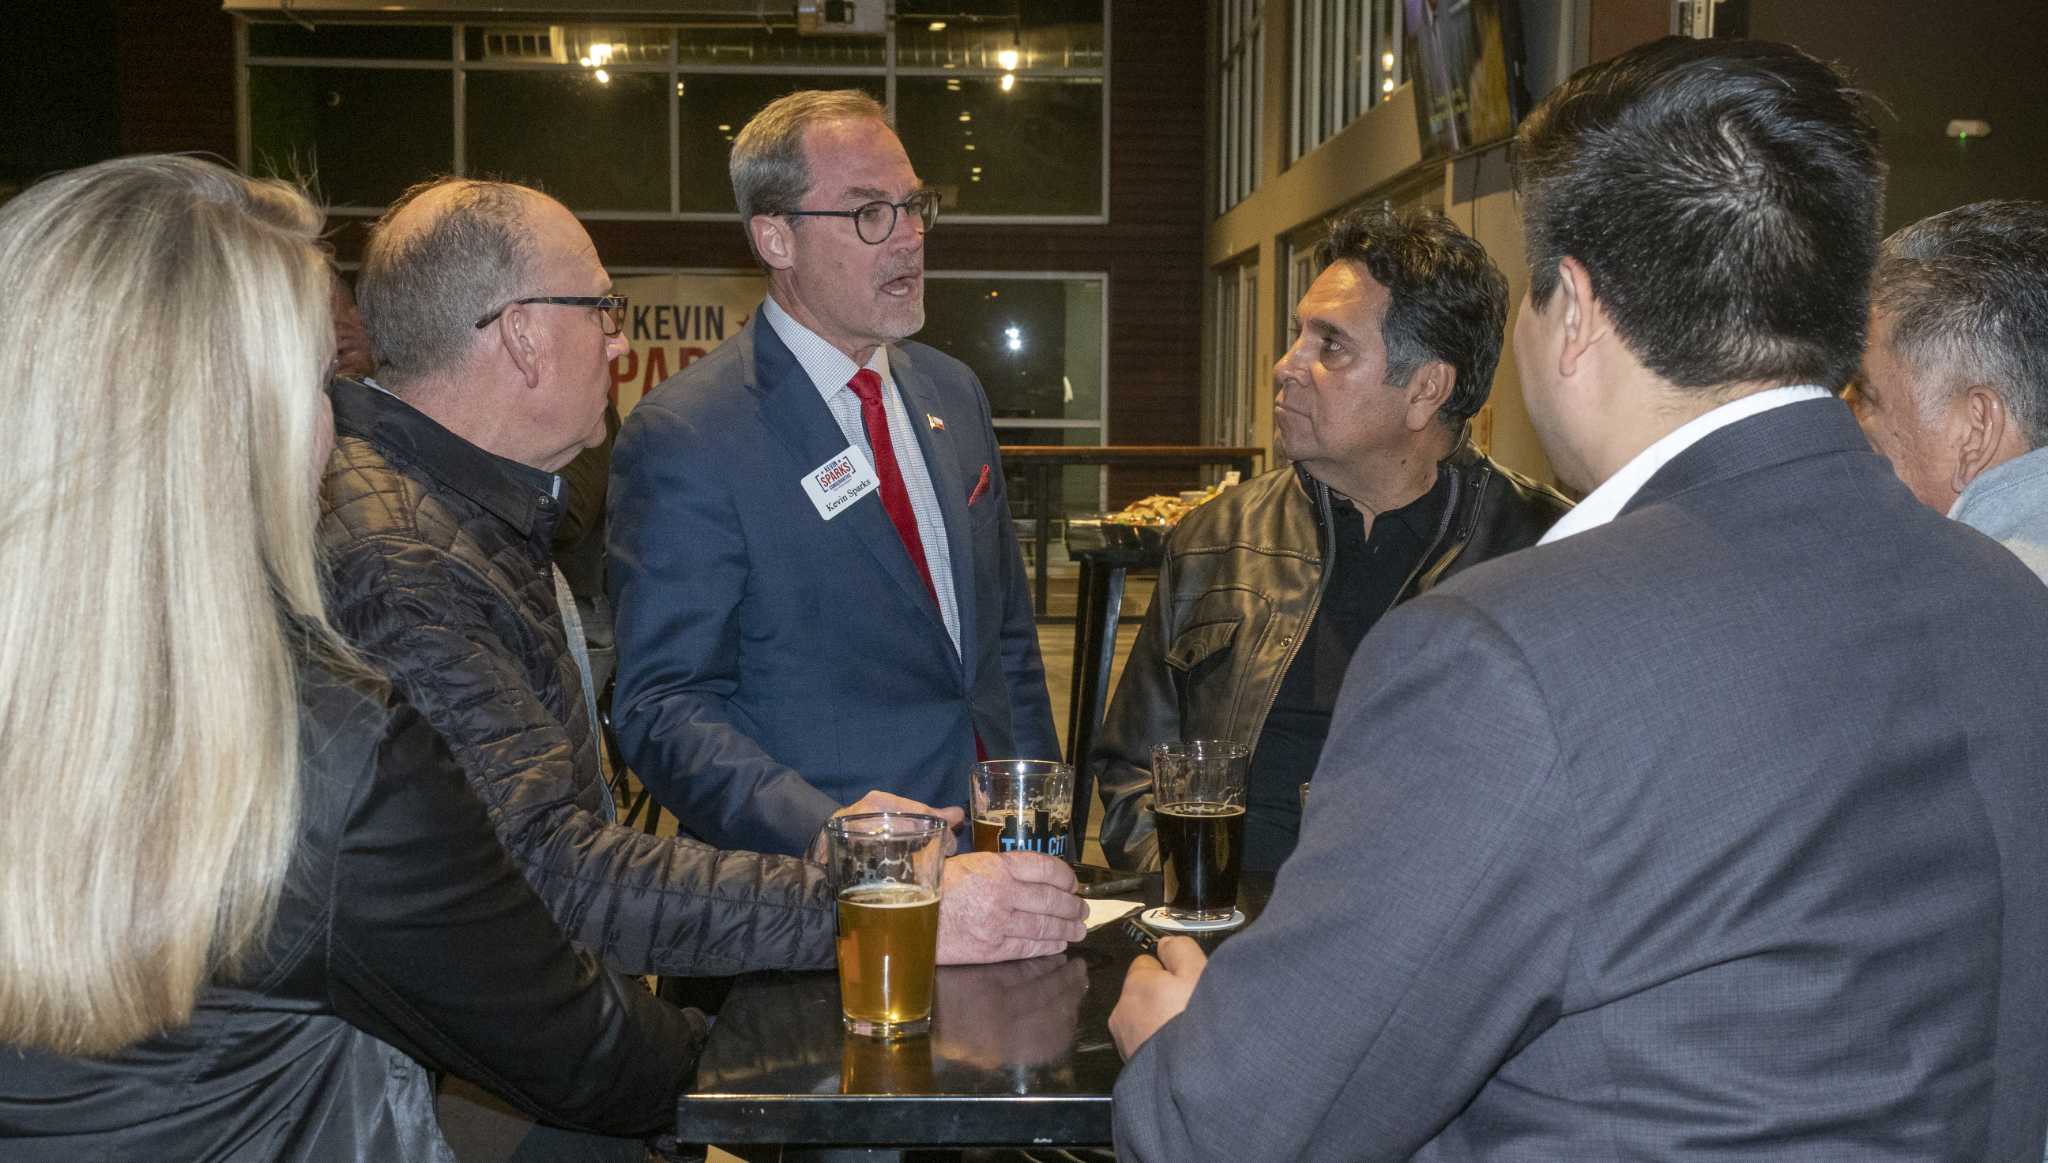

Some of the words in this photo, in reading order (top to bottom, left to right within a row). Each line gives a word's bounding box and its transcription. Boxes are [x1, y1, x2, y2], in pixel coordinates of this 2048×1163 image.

[633, 305, 724, 340] KEVIN
[820, 461, 852, 487] SPARKS
[824, 461, 838, 472] KEVIN
[825, 495, 849, 511] Kevin
[847, 479, 871, 497] Sparks
